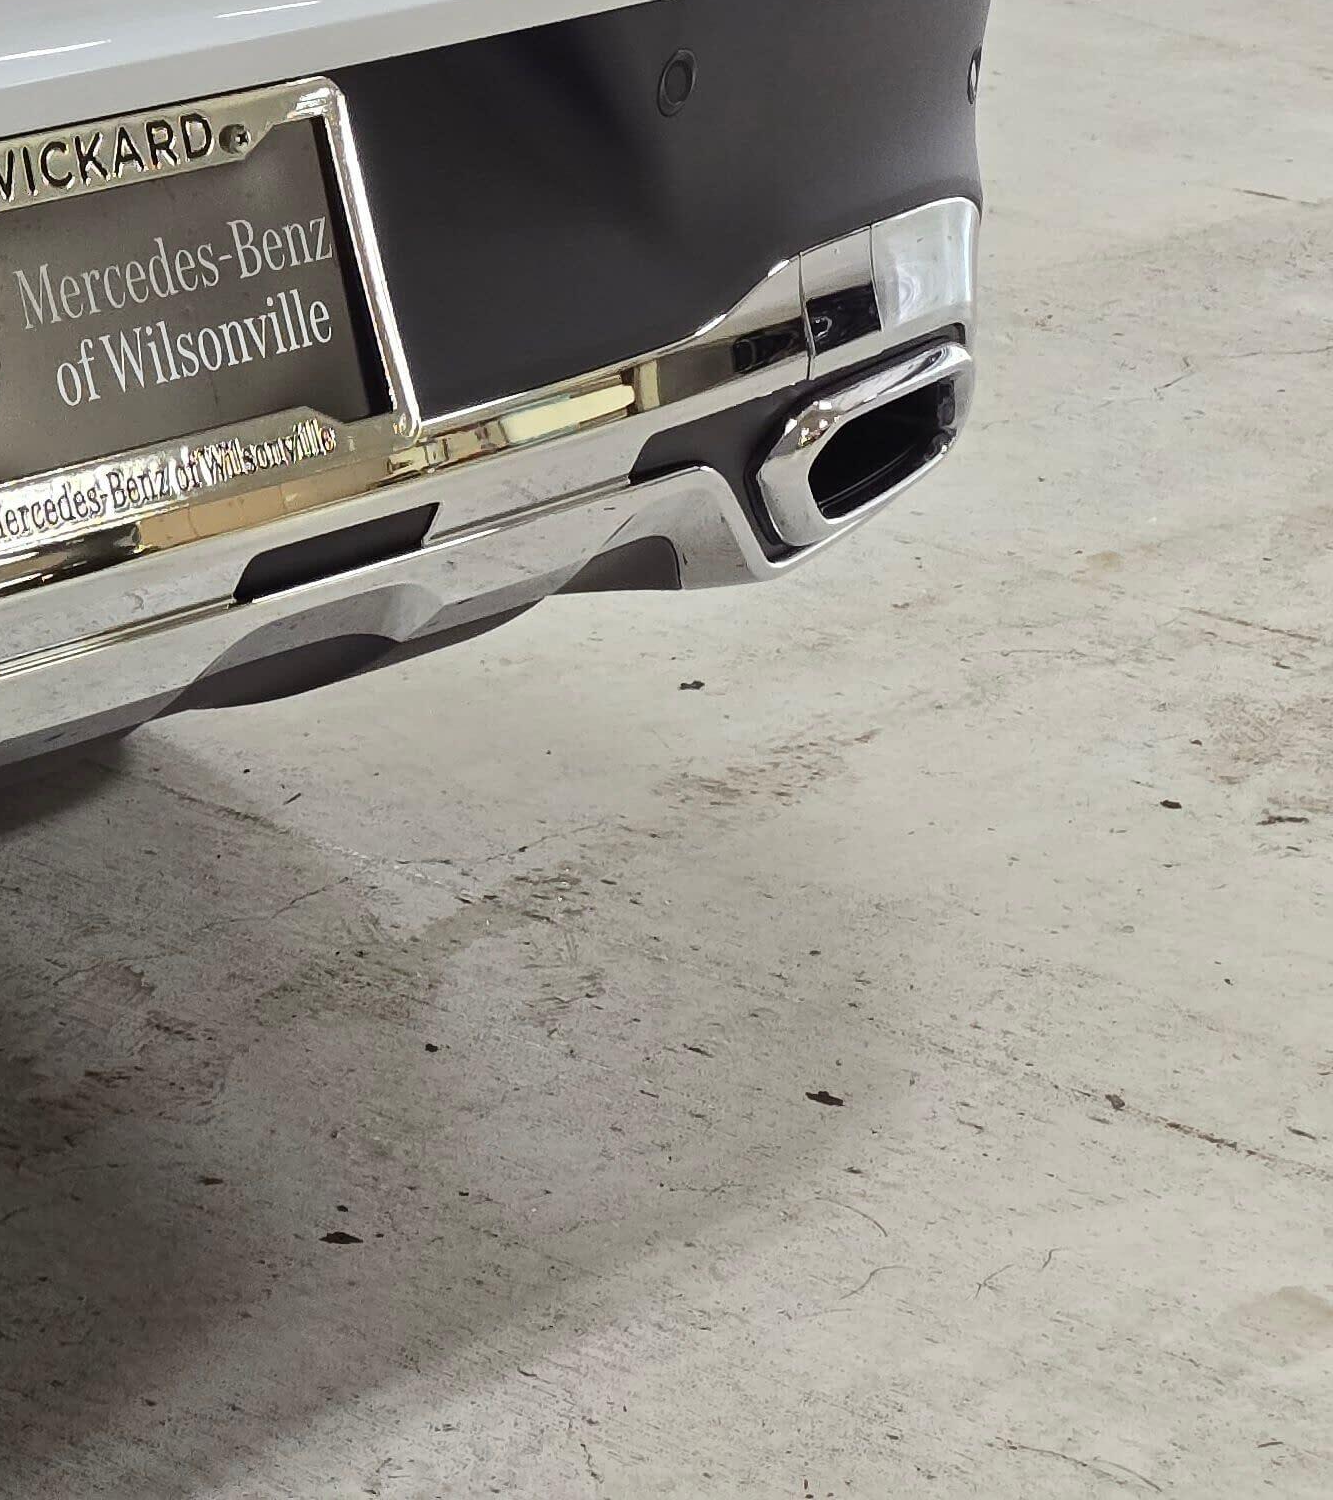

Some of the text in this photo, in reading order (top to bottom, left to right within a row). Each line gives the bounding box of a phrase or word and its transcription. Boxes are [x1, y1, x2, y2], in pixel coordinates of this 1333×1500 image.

[13, 216, 333, 329] Mercedes-Benz
[56, 289, 332, 406] of Wilsonville
[198, 418, 336, 487] Wilsonville
